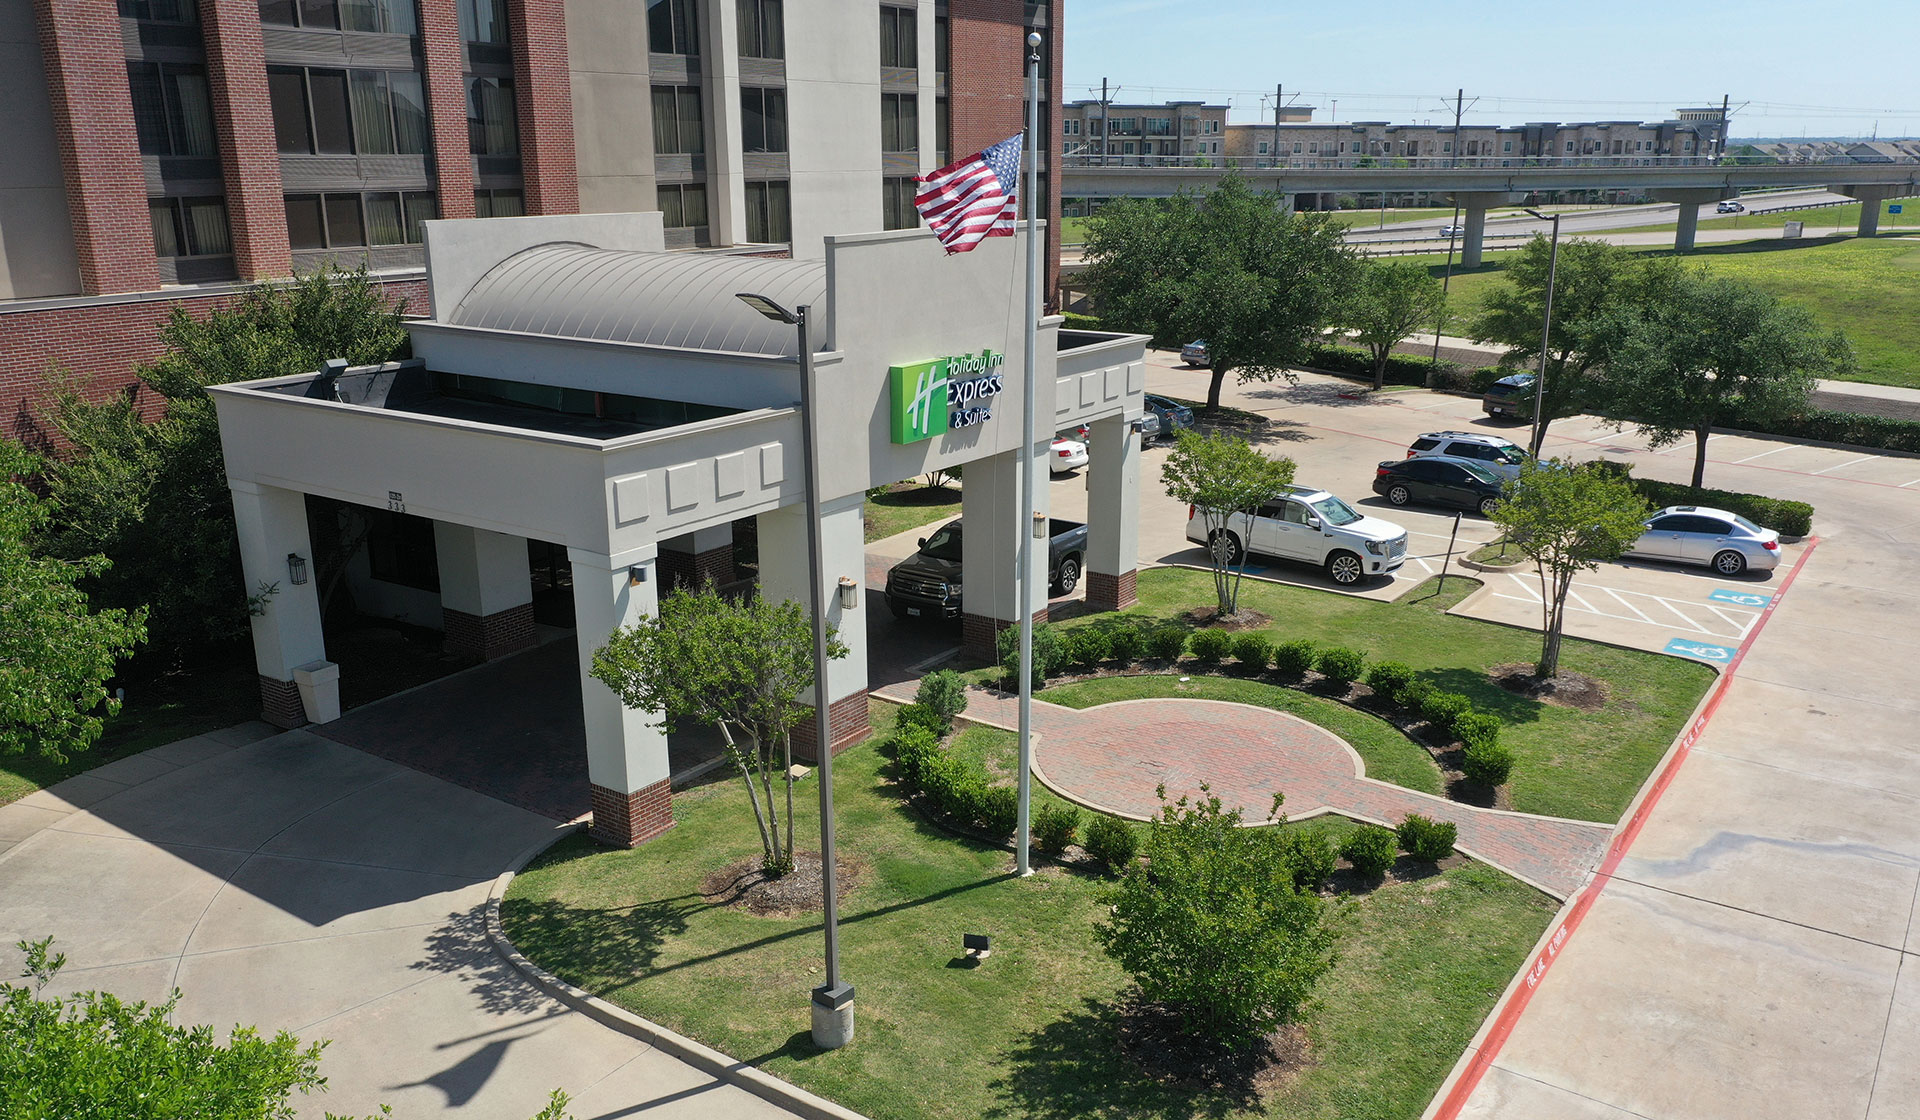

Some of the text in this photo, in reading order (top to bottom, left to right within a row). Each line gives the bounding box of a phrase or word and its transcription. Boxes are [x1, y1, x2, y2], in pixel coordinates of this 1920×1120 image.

[946, 353, 1004, 376] Holiday Inn
[946, 375, 1003, 409] Express
[954, 408, 993, 429] & Suites
[387, 500, 406, 513] 333
